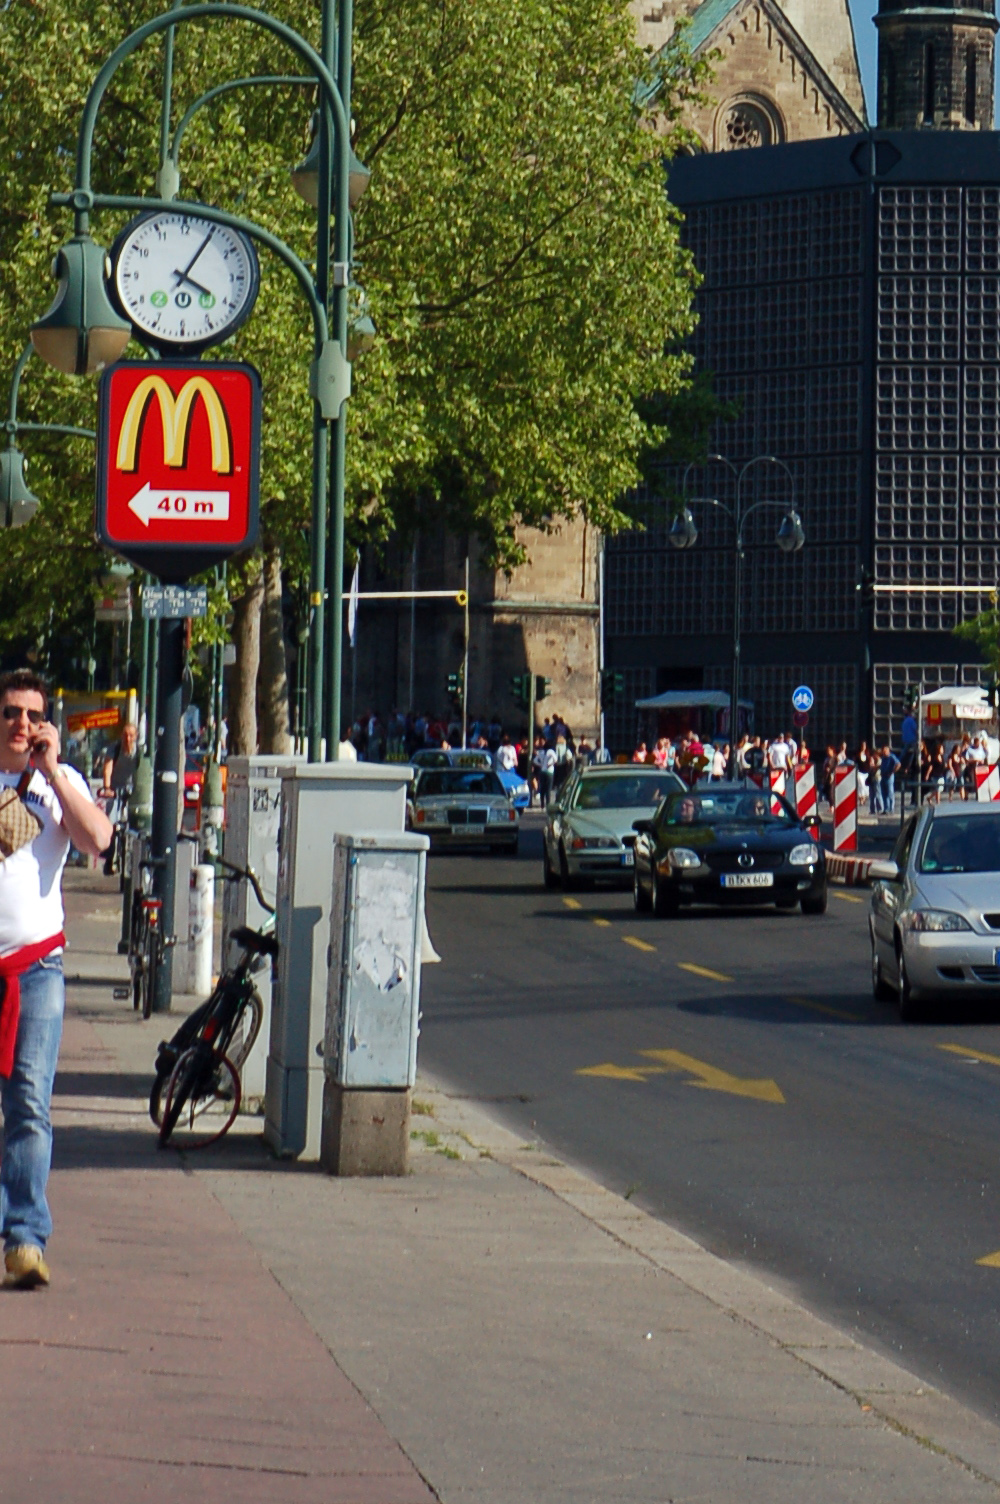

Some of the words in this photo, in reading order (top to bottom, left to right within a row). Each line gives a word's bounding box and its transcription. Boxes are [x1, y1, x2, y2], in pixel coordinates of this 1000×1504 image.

[181, 224, 190, 235] 12
[158, 232, 167, 242] 11
[140, 247, 149, 258] 10
[157, 497, 187, 513] 40
[194, 501, 214, 513] m
